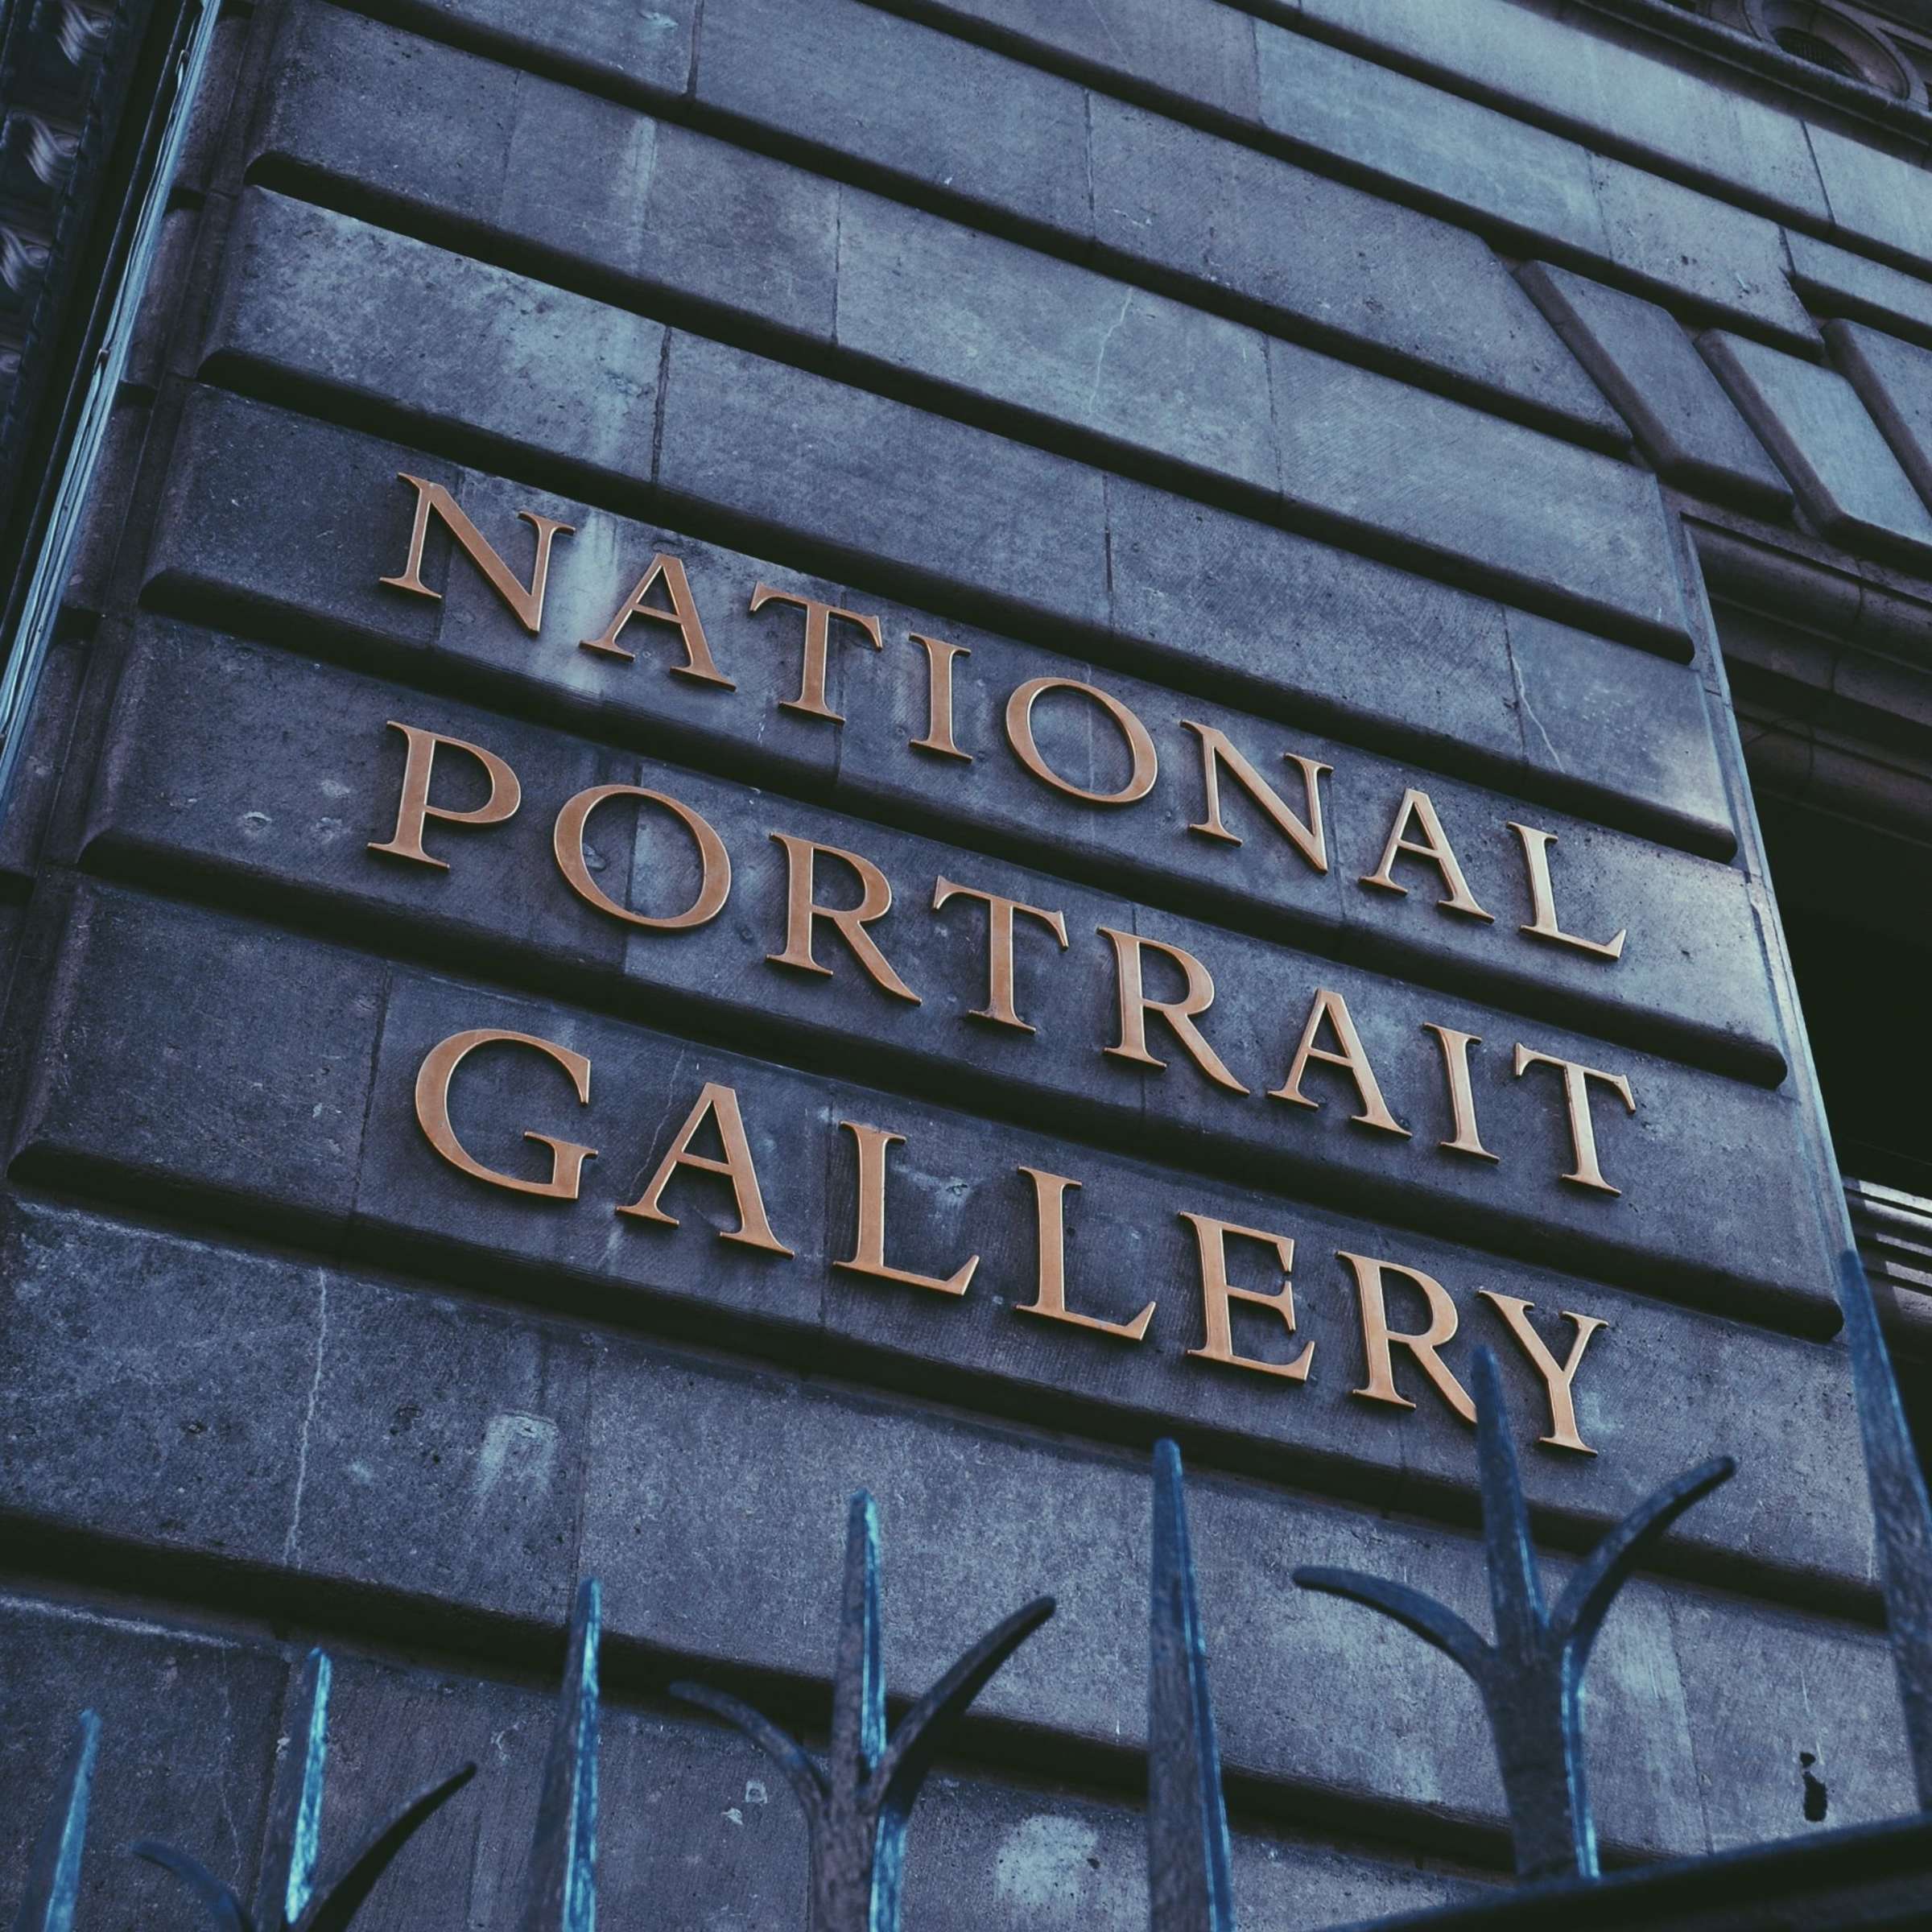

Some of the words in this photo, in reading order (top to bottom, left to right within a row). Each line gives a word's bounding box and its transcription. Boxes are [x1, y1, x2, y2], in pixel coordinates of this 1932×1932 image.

[379, 473, 1626, 960] NATIONAL
[368, 720, 1636, 1195] PORTRAIT
[415, 1028, 1608, 1455] GALLERY
